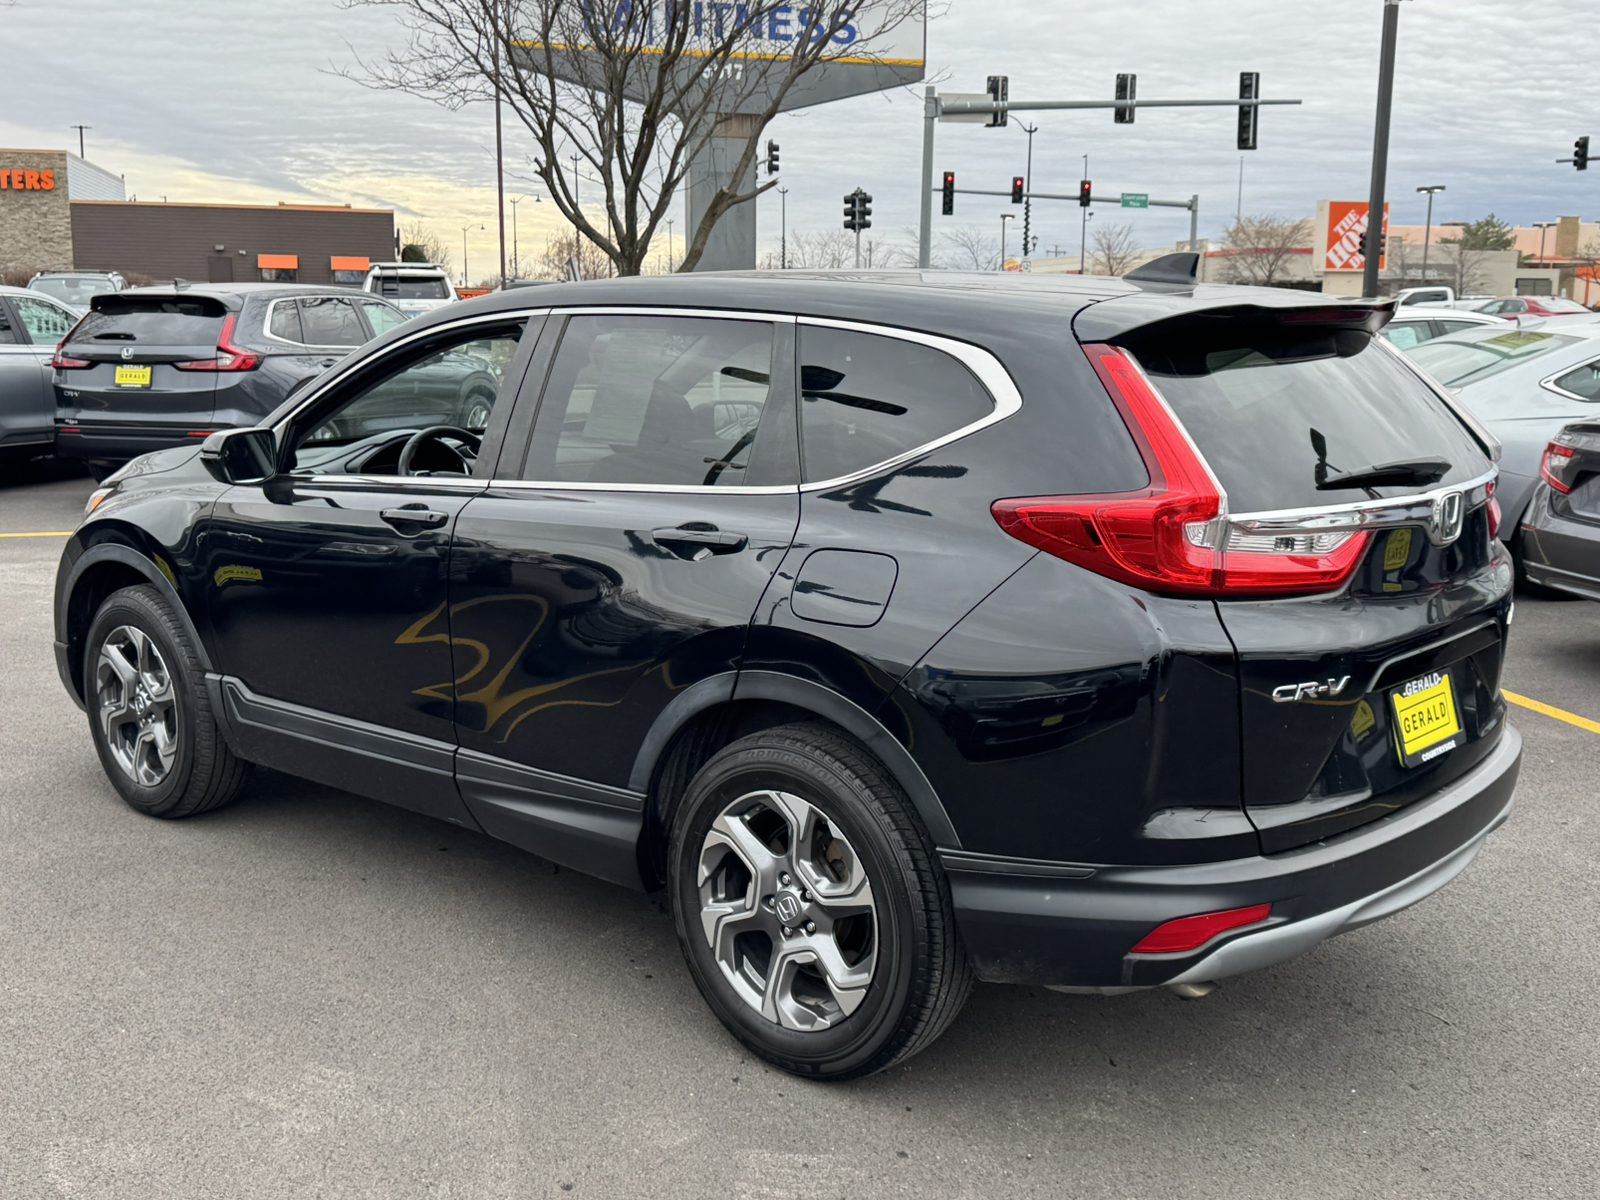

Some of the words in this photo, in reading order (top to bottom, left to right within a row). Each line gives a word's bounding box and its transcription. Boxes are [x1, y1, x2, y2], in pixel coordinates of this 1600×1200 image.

[1333, 209, 1361, 237] THE
[1272, 675, 1351, 703] CR-V
[1405, 672, 1440, 696] GERALD
[1403, 702, 1446, 734] GERALD
